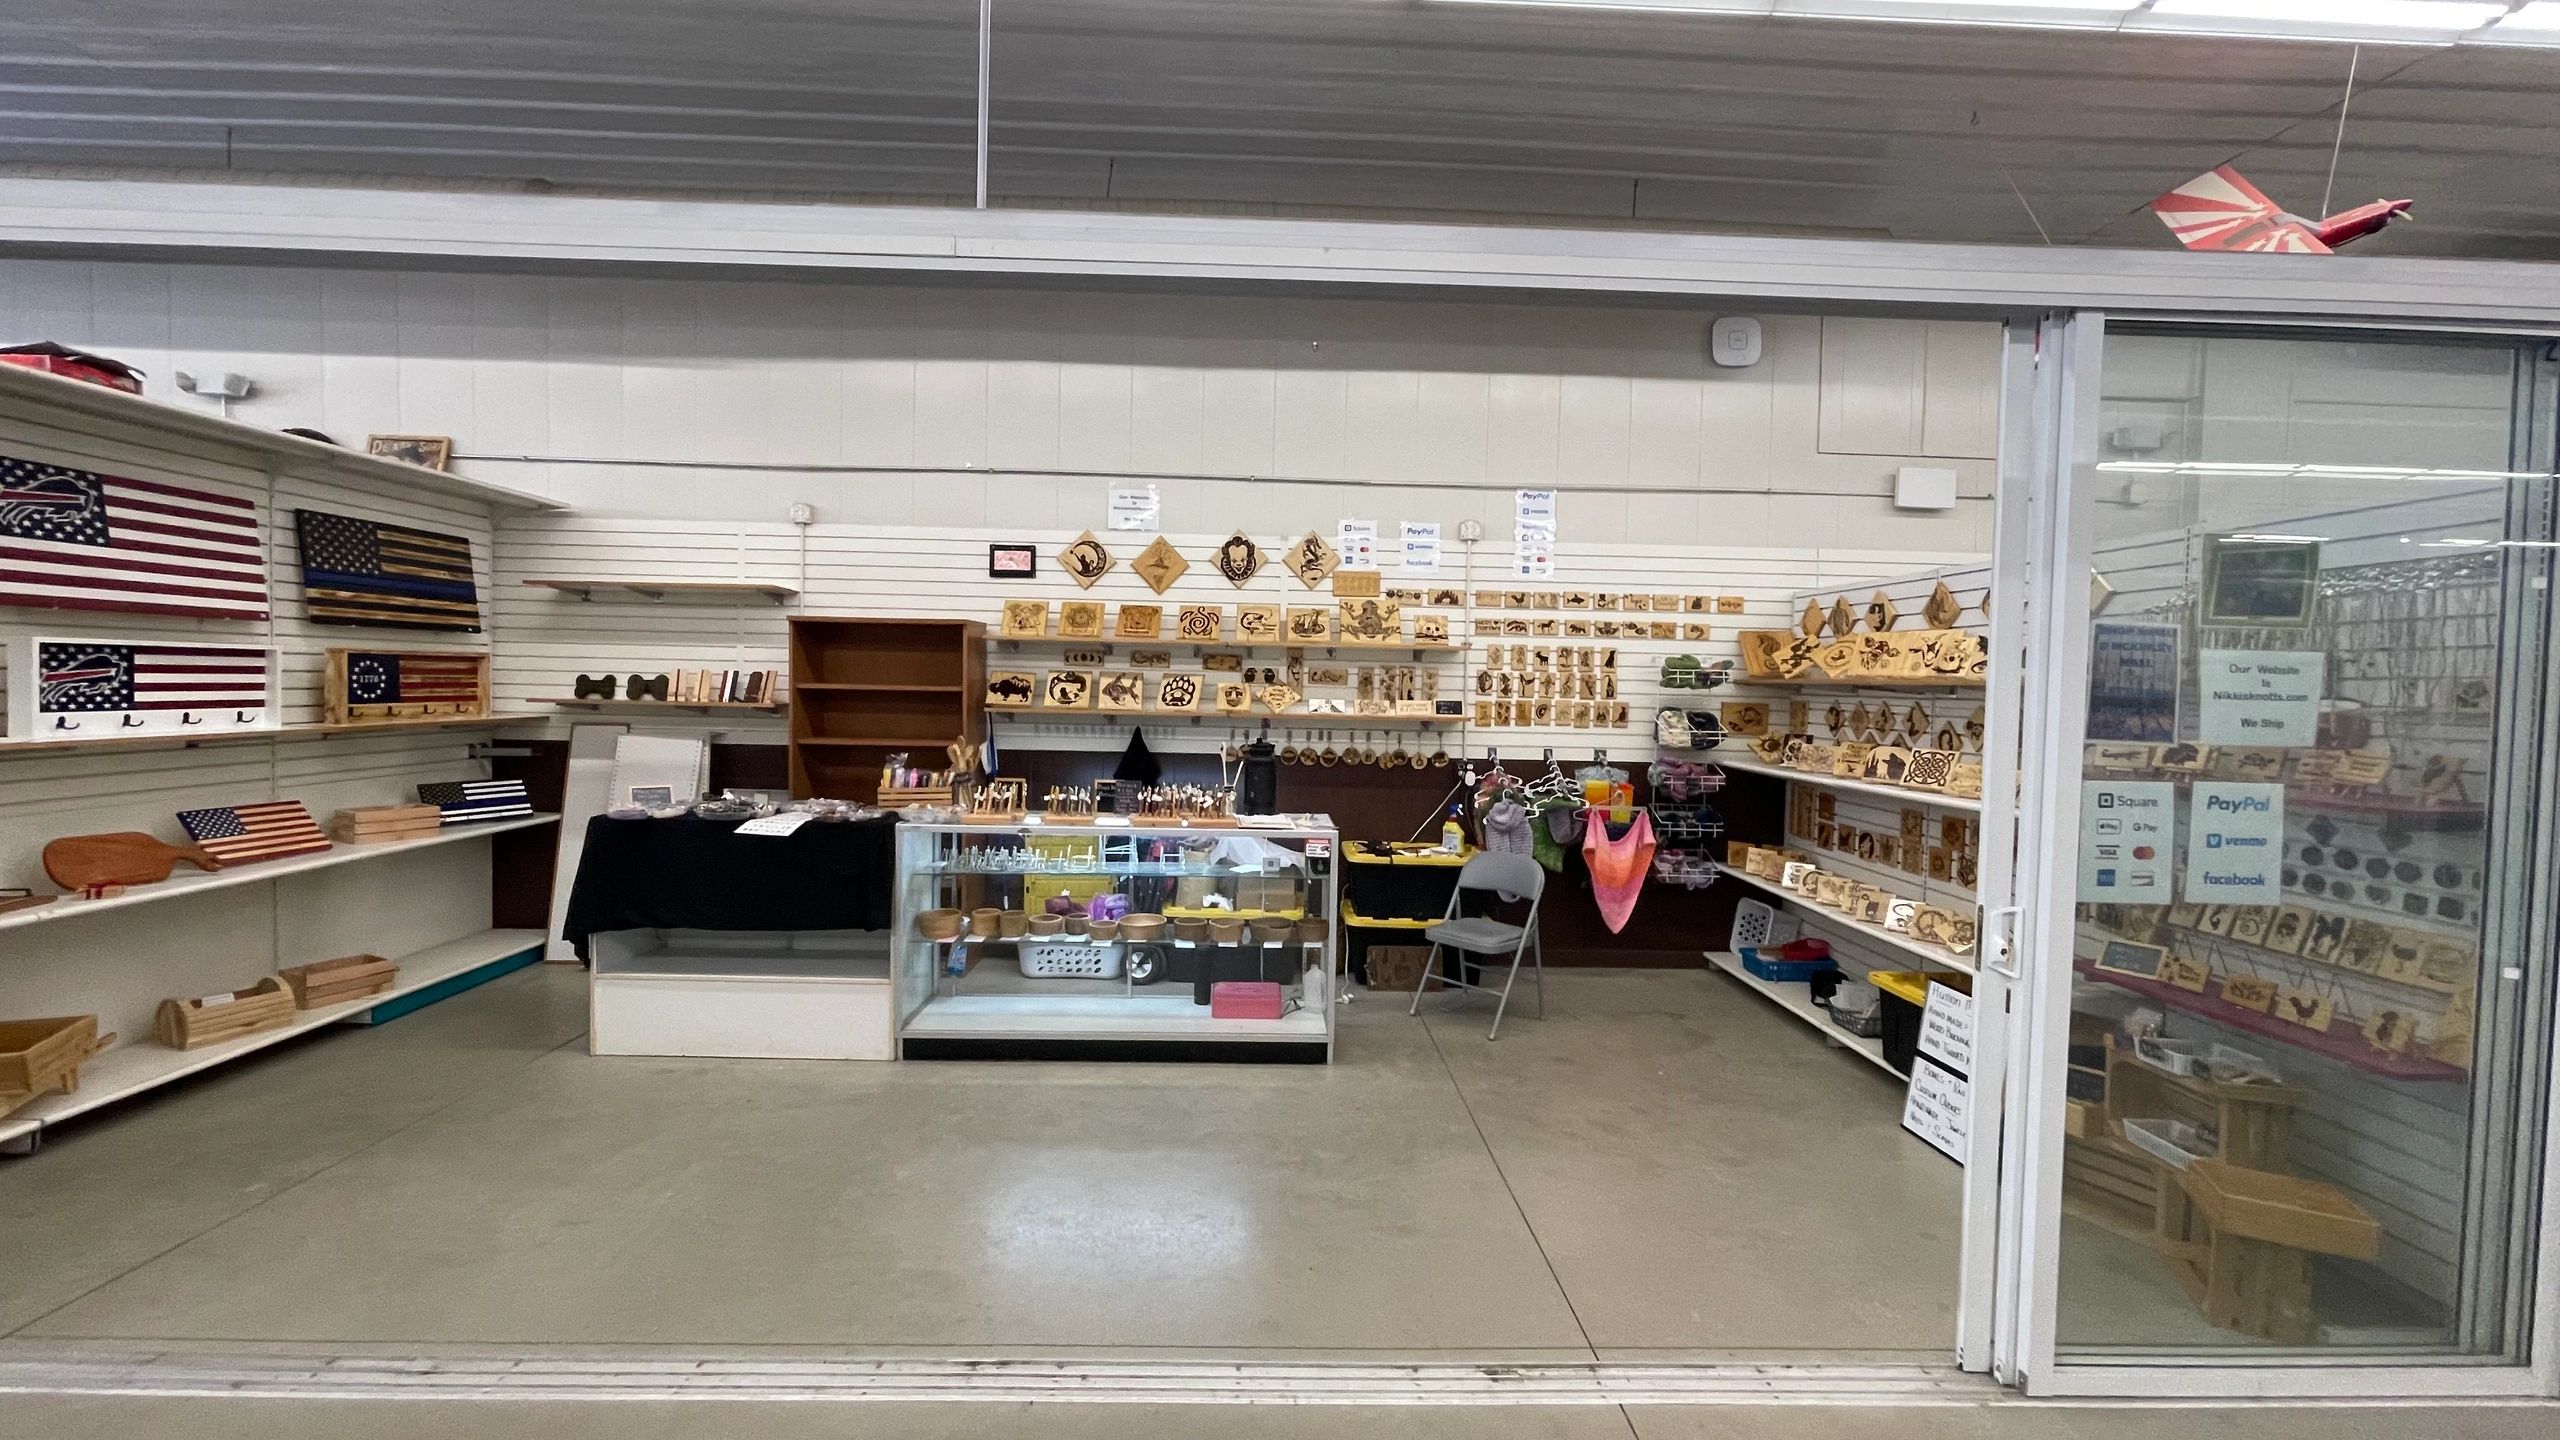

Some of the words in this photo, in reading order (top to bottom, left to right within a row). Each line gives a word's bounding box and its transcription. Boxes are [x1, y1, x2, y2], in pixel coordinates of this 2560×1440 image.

[1522, 492, 1550, 500] PayPal
[1406, 527, 1435, 535] PayPal
[2229, 663, 2251, 673] Our
[2257, 665, 2300, 675] Website
[360, 675, 379, 683] 1776
[2240, 718, 2258, 728] We
[2261, 719, 2285, 729] Ship
[2117, 795, 2159, 808] Square
[2206, 795, 2270, 814] PayPal
[2225, 837, 2268, 847] venmo
[2203, 871, 2265, 886] facebook
